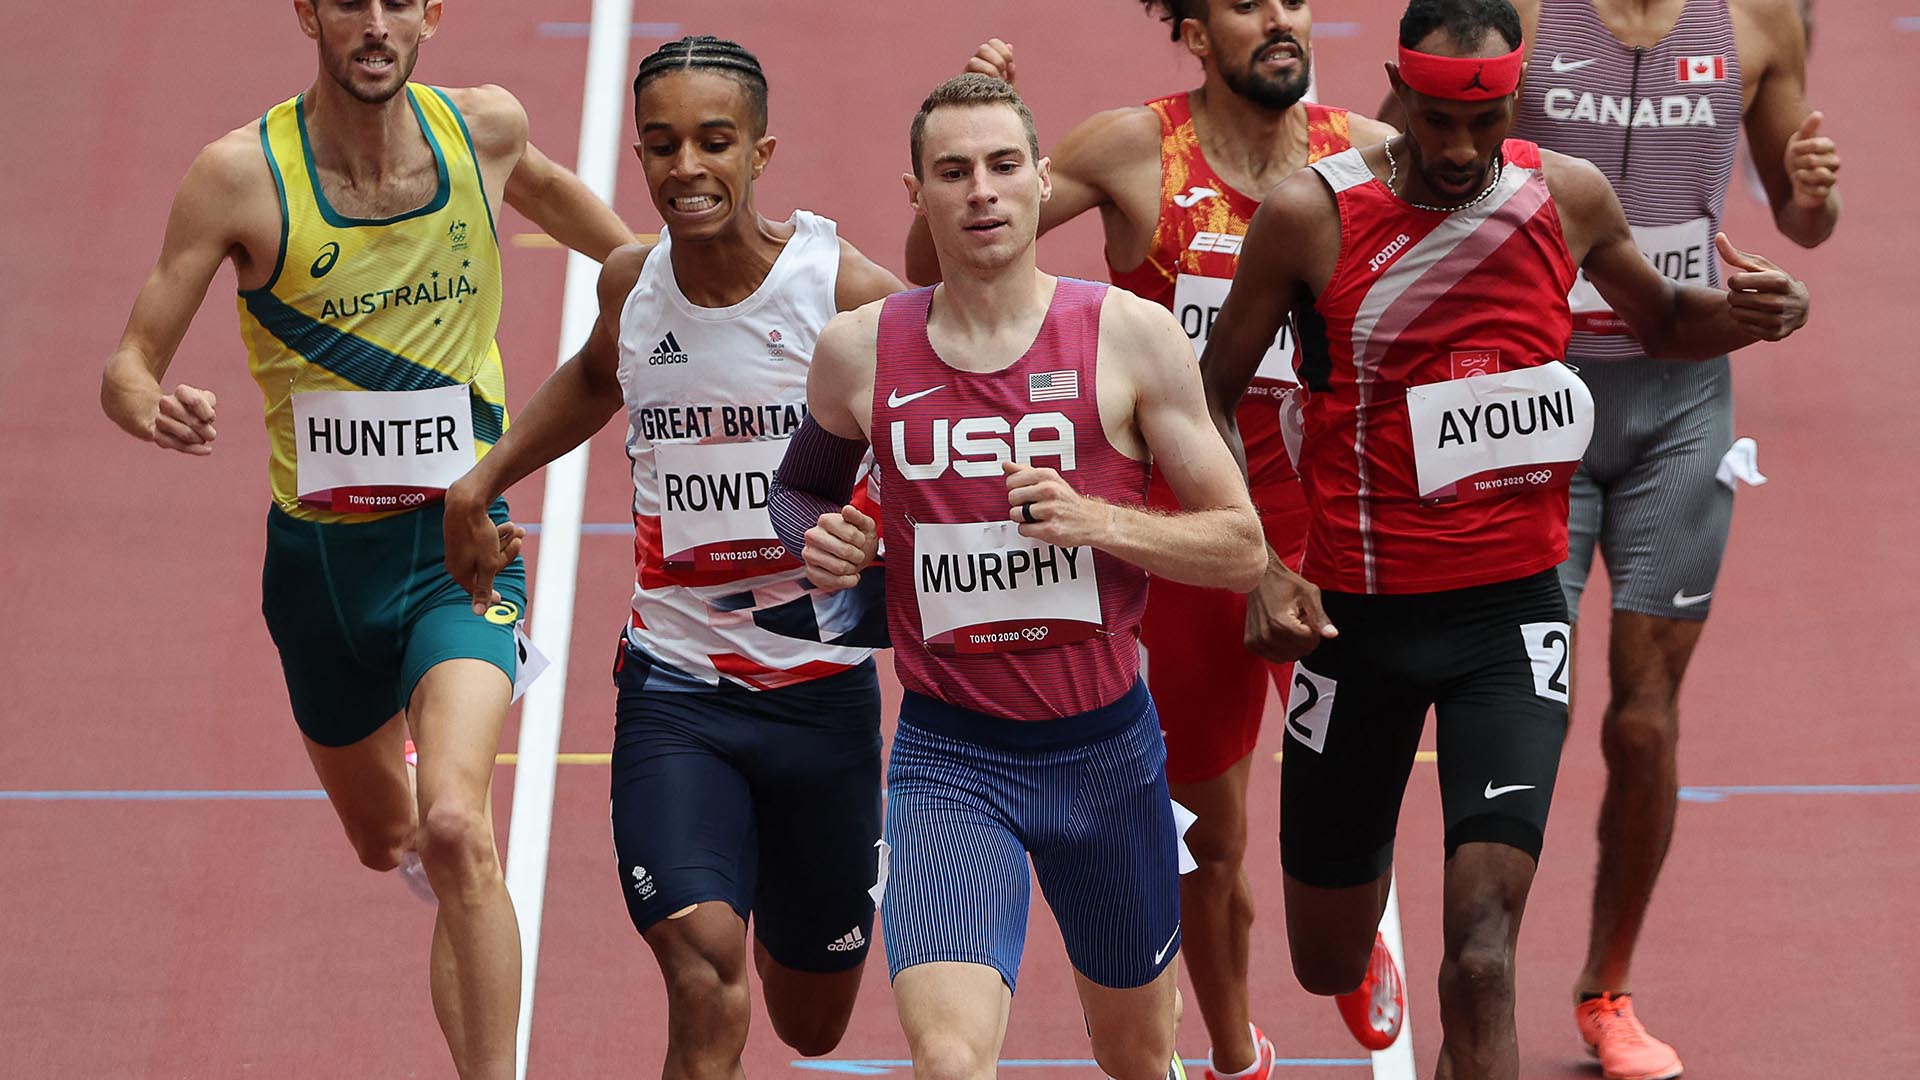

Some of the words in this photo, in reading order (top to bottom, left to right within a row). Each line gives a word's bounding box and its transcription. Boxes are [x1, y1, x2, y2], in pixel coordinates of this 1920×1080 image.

[1544, 88, 1717, 127] CANADA
[1188, 231, 1243, 255] ES
[320, 274, 473, 319] AUSTRALIA
[648, 352, 688, 366] adidas
[308, 415, 459, 456] HUNTER
[640, 406, 712, 440] GREAT
[1438, 388, 1575, 449] AYOUNI
[890, 411, 1076, 480] USA
[348, 495, 375, 505] TOKYO
[376, 495, 397, 505] 2020
[665, 471, 778, 512] ROWD
[1474, 480, 1503, 490] TOKYO
[1504, 476, 1525, 486] 2020
[710, 551, 736, 561] TOKYO
[737, 550, 757, 560] 2020
[921, 544, 1079, 593] MURPHY
[970, 633, 997, 643] TOKYO
[998, 632, 1020, 642] 2020
[1543, 630, 1568, 695] 2
[1288, 673, 1319, 740] 2
[827, 937, 865, 951] adidas
